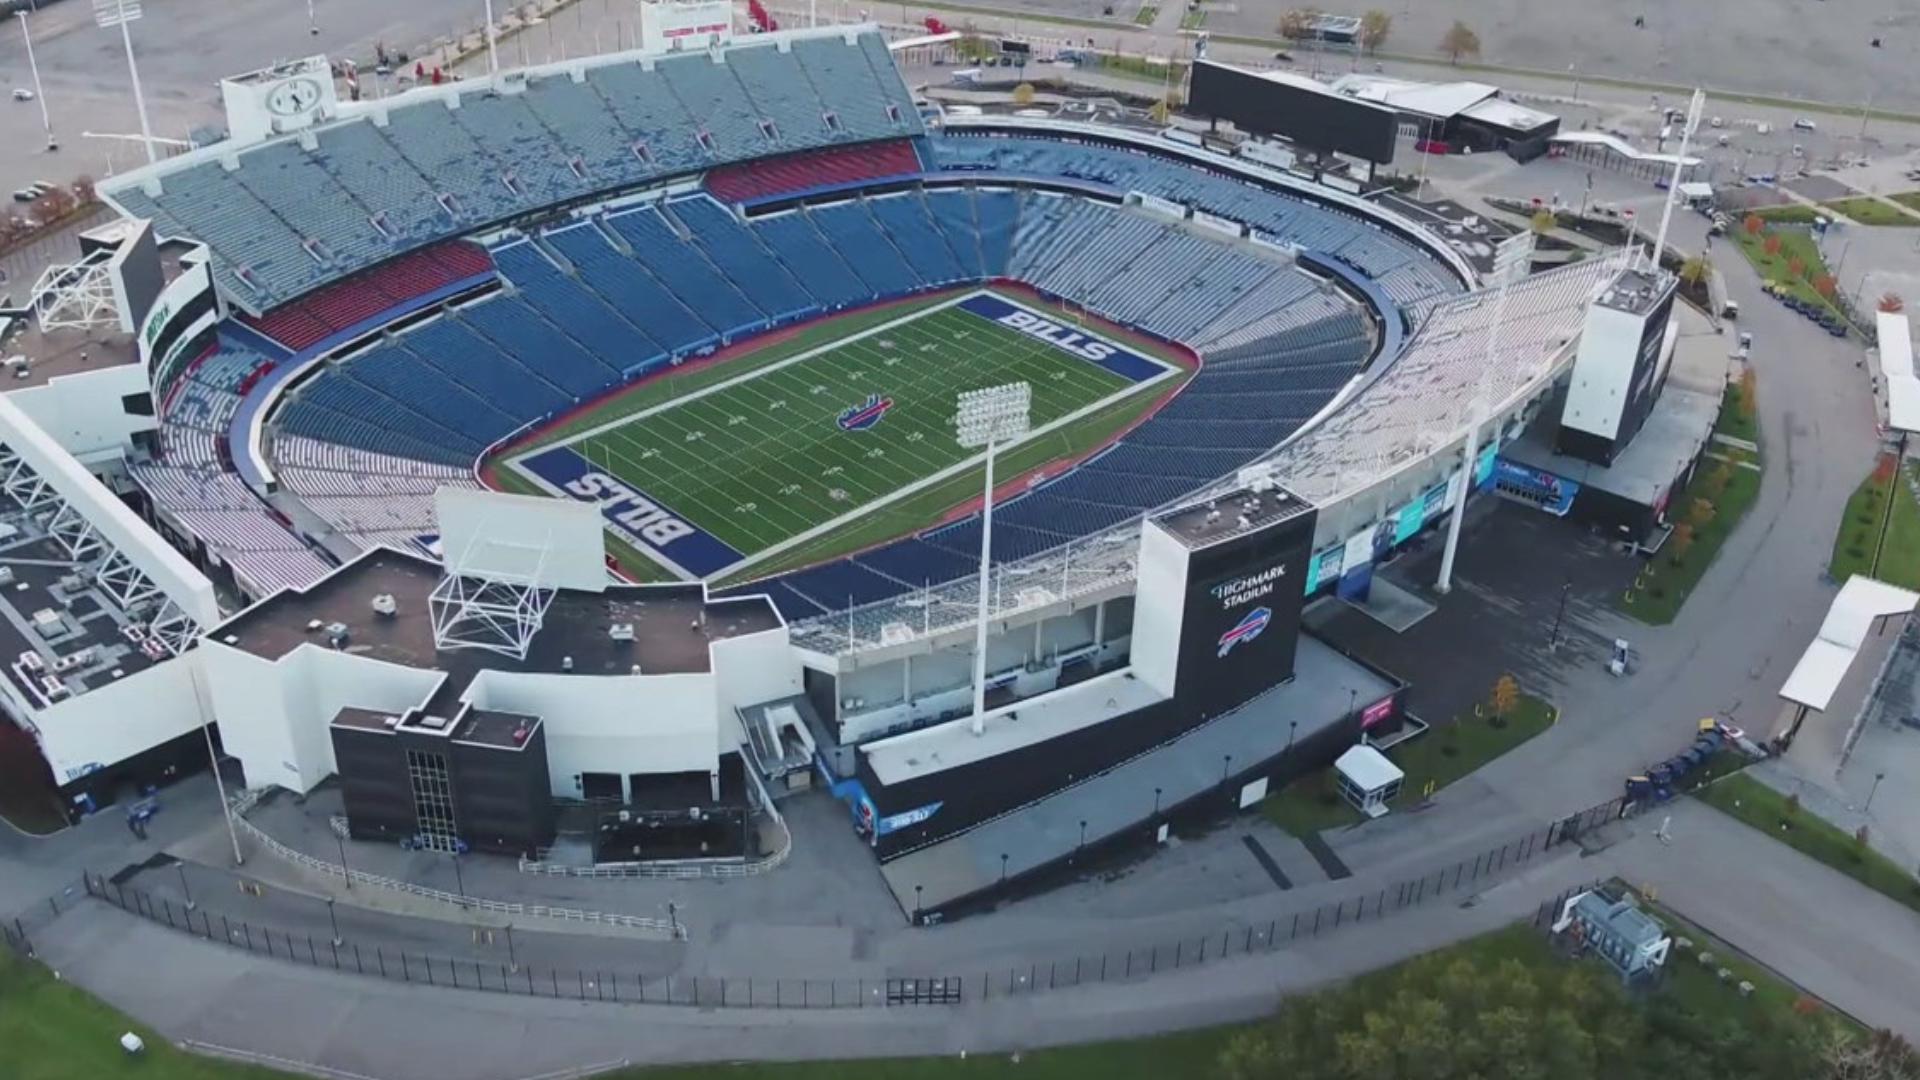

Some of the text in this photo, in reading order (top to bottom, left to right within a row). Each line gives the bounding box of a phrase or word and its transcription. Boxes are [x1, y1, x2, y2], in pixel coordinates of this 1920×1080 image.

[997, 311, 1117, 361] BILLS
[565, 472, 696, 547] BILLS
[1210, 564, 1287, 600] HIGHMARK
[1223, 583, 1274, 610] STADIUM
